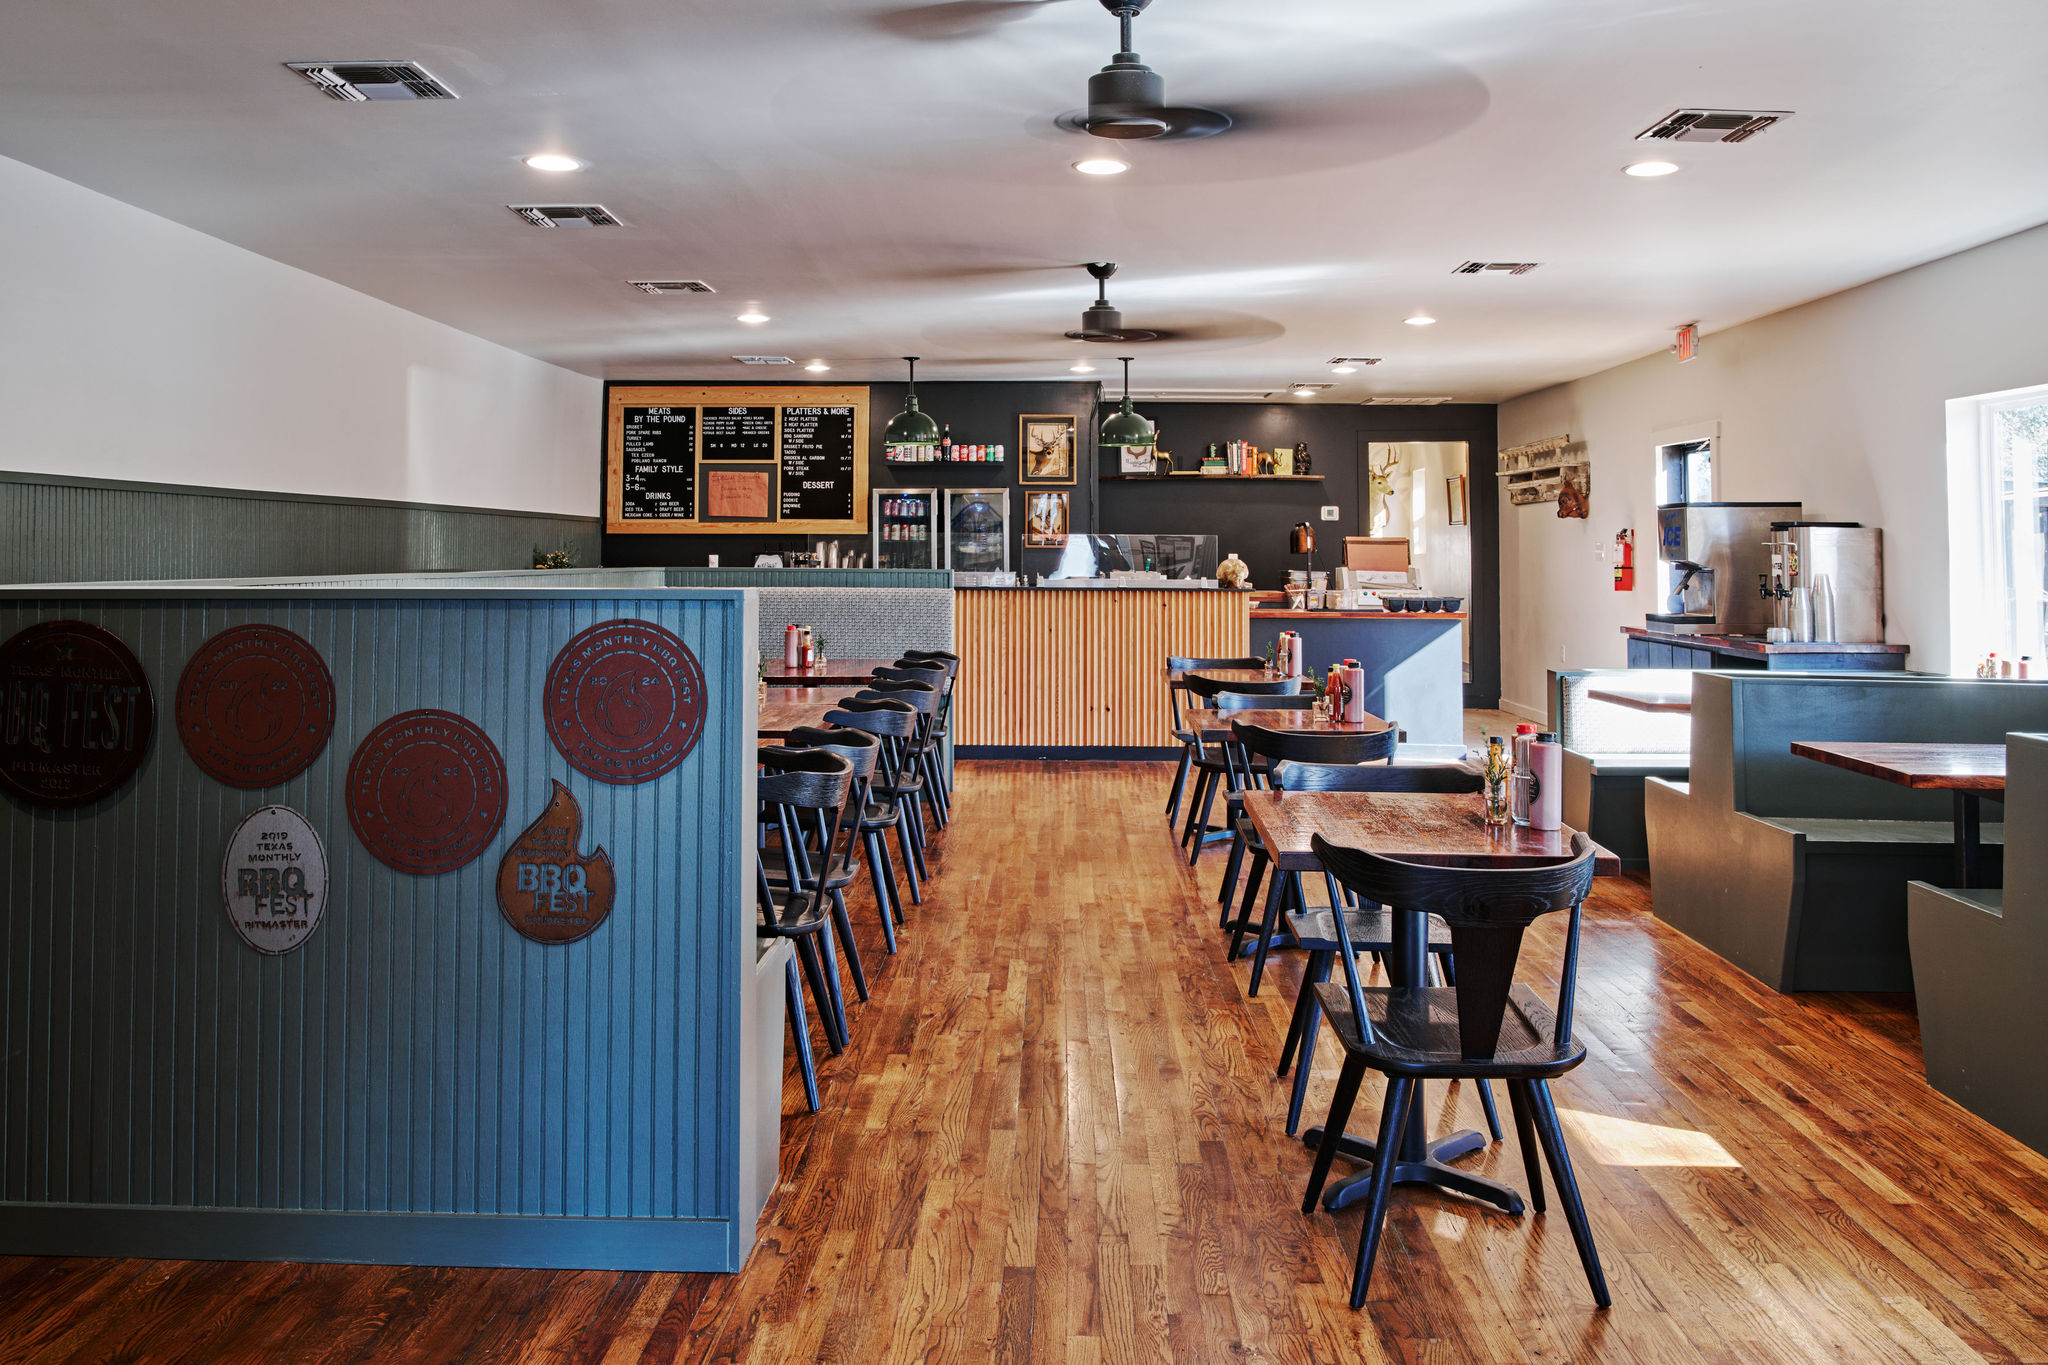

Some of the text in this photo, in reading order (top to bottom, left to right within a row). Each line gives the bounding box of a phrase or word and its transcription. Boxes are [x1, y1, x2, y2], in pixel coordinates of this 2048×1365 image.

[1678, 328, 1692, 360] EXIT
[1663, 526, 1681, 546] ICE
[212, 639, 280, 662] MONTHLY
[582, 635, 651, 659] MONTHLY
[0, 680, 142, 754] BQ FEST
[384, 726, 452, 750] MONTHLY
[256, 842, 294, 851] TEXAS
[260, 832, 288, 840] 2019
[530, 838, 568, 847] TEXAS
[248, 852, 302, 862] MONTHLY
[238, 866, 306, 898] BBQ
[517, 863, 588, 894] BBQ
[254, 890, 314, 917] FEST
[534, 888, 596, 912] FEST
[244, 920, 308, 930] PITMASTER
